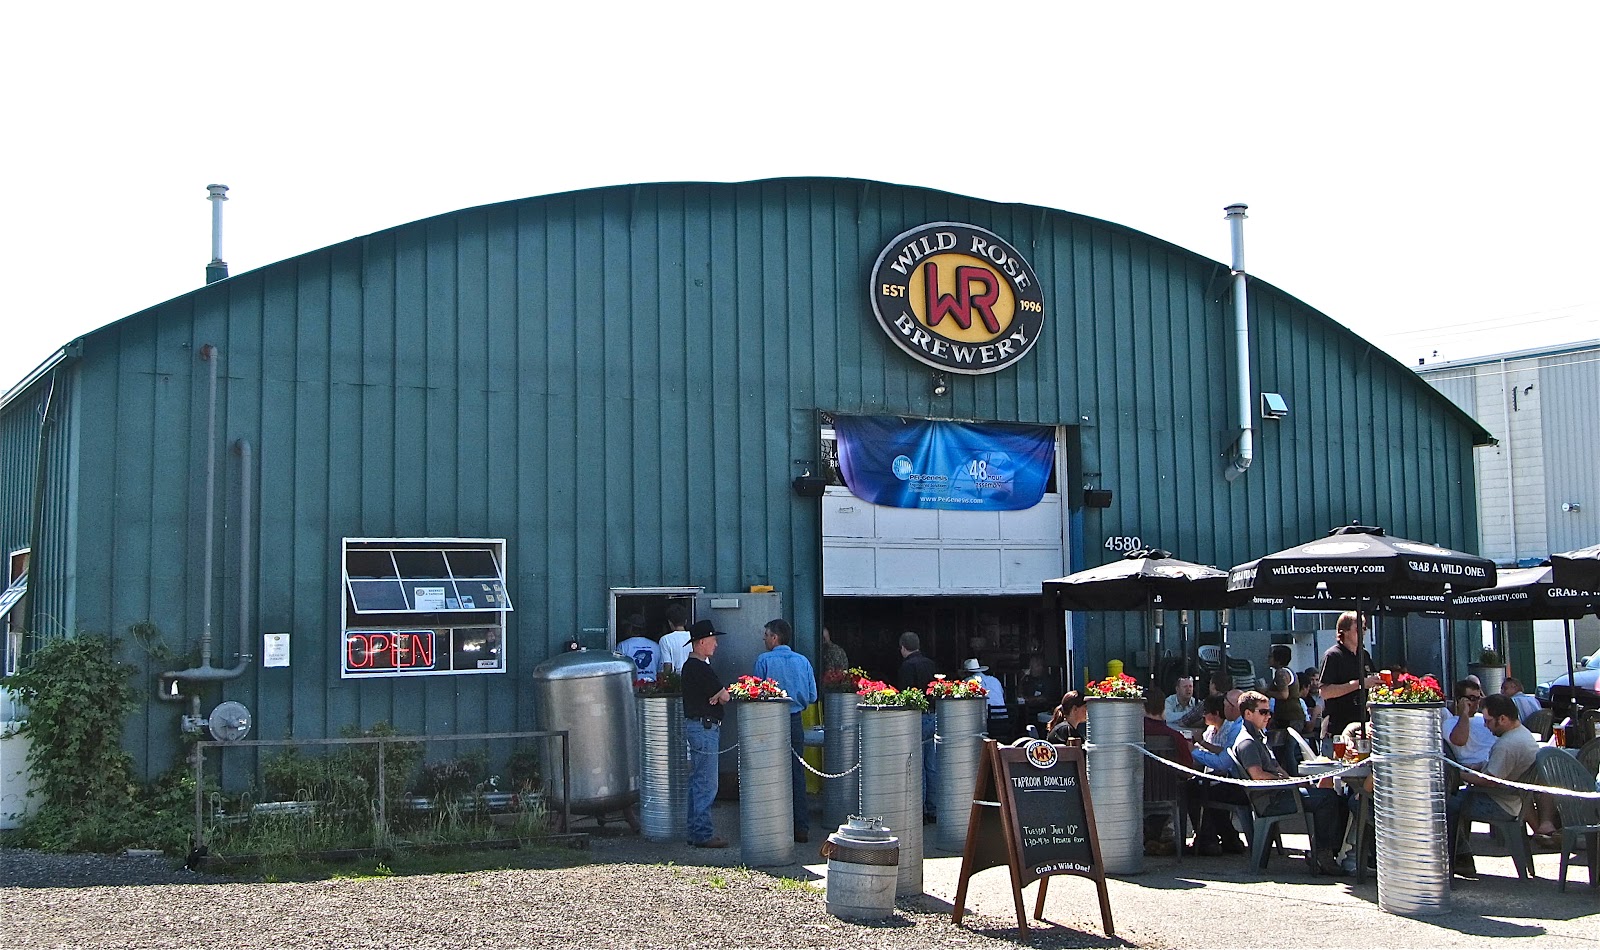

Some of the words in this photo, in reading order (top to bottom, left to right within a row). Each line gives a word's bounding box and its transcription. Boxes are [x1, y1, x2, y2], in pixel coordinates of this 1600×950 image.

[890, 232, 957, 276] WILD
[970, 235, 1031, 292] ROSE
[882, 283, 905, 298] EST
[1020, 300, 1042, 312] 1996
[894, 310, 1028, 364] BREWERY
[969, 459, 987, 480] 48
[1104, 536, 1141, 551] 4580
[1272, 564, 1385, 575] wildrosebrewery.com
[1408, 561, 1430, 572] GRAB
[1432, 562, 1439, 573] A
[1440, 563, 1462, 575] WILD
[1452, 591, 1528, 605] wildrosebrewery.com
[348, 634, 432, 668] OPEN
[1011, 776, 1041, 788] TAPROOM
[1043, 775, 1076, 787] BOOKINGS
[1035, 864, 1051, 874] Grab
[1058, 862, 1073, 870] Wild
[1074, 863, 1090, 873] One!
